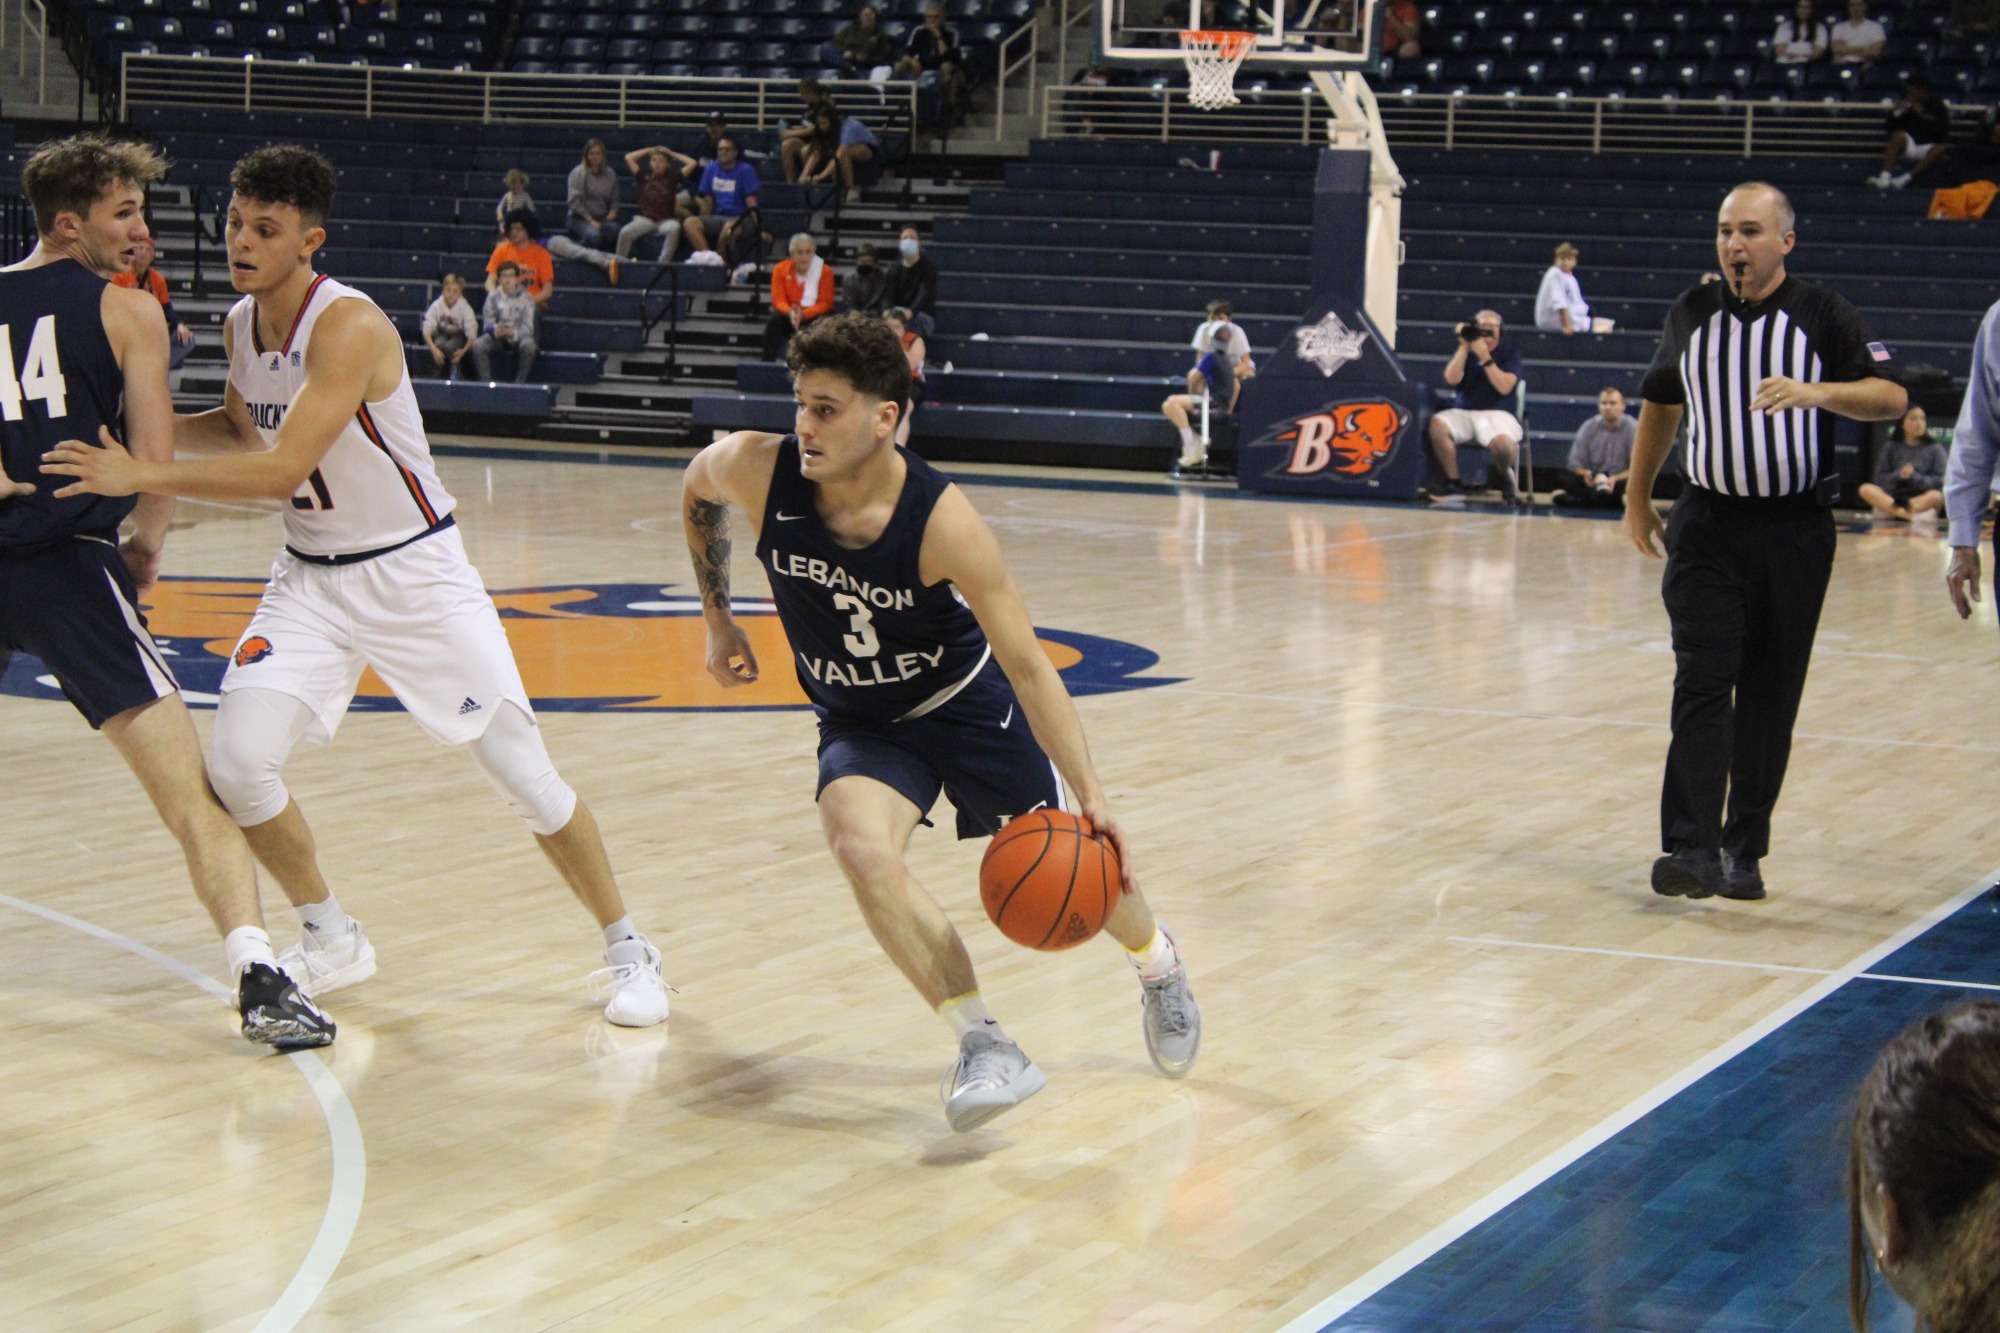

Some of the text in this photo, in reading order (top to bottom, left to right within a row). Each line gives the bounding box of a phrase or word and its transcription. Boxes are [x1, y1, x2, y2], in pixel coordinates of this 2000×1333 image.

[245, 402, 288, 431] BUCK
[1287, 414, 1335, 474] B
[772, 549, 915, 611] LEBANON
[833, 592, 880, 658] 3
[800, 645, 944, 687] VALLEY
